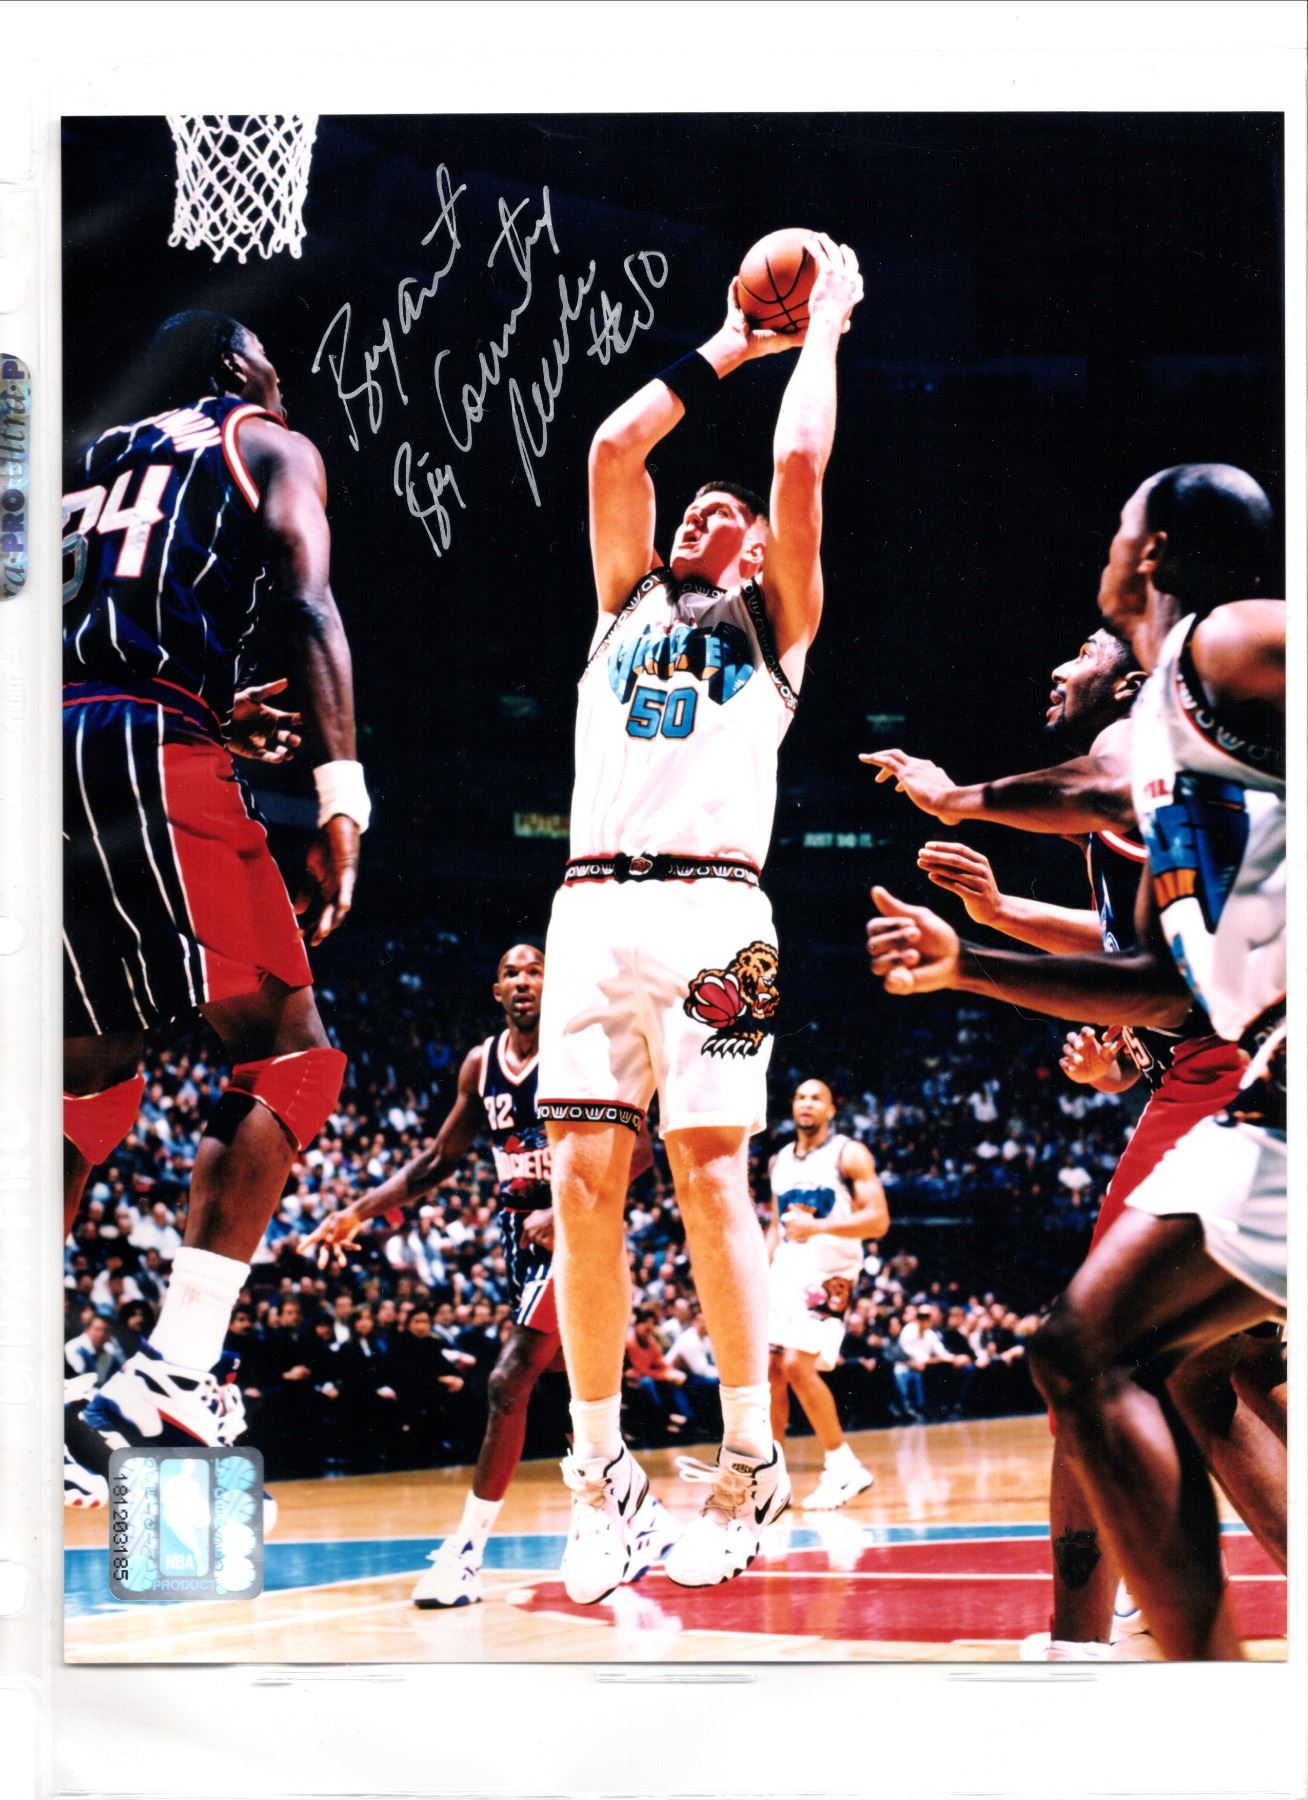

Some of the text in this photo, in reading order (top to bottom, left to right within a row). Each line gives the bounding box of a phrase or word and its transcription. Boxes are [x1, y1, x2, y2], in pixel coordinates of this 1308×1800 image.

[625, 685, 699, 740] 50
[112, 1472, 129, 1581] 181203185
[165, 1554, 191, 1571] NBA
